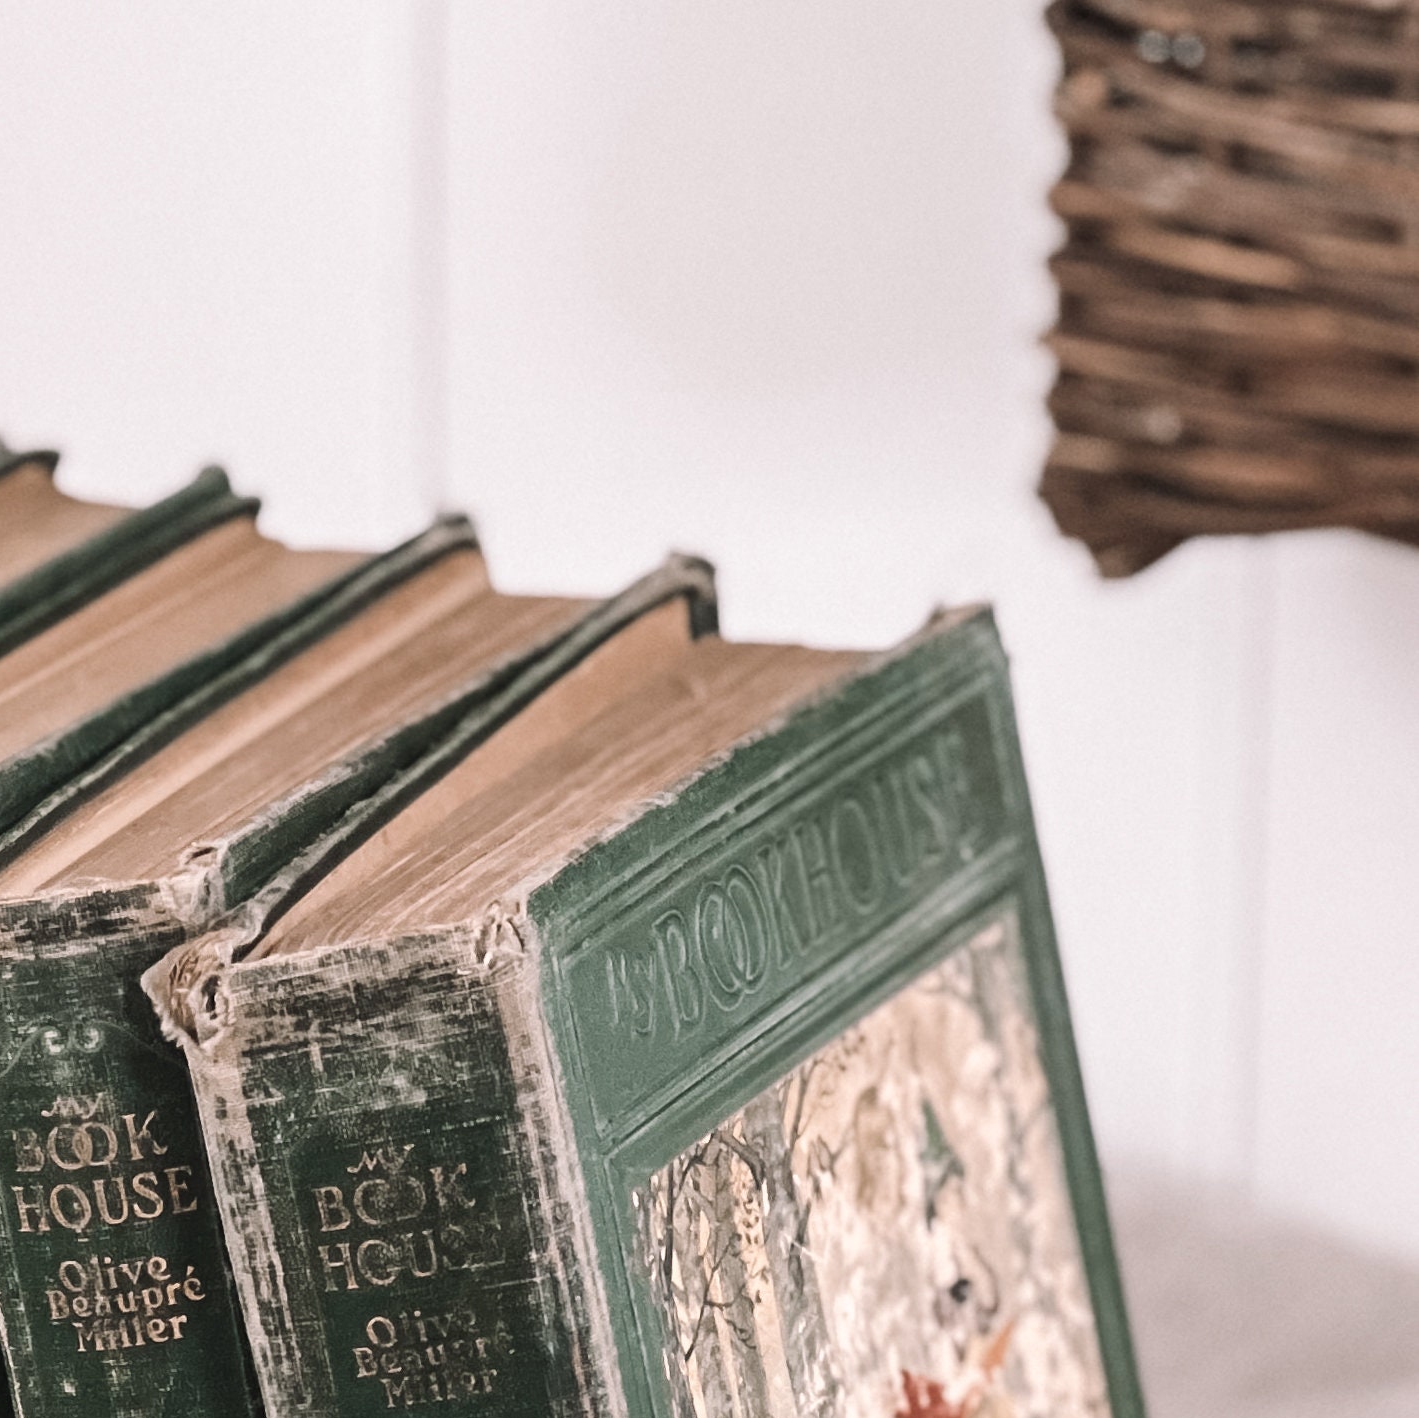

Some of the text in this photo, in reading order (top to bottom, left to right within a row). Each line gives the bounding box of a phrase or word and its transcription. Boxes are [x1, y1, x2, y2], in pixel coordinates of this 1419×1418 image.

[12, 1110, 168, 1173] BOOK
[11, 1166, 198, 1234] HOUSE
[59, 1256, 171, 1293] Olive
[73, 1314, 188, 1352] Miller
